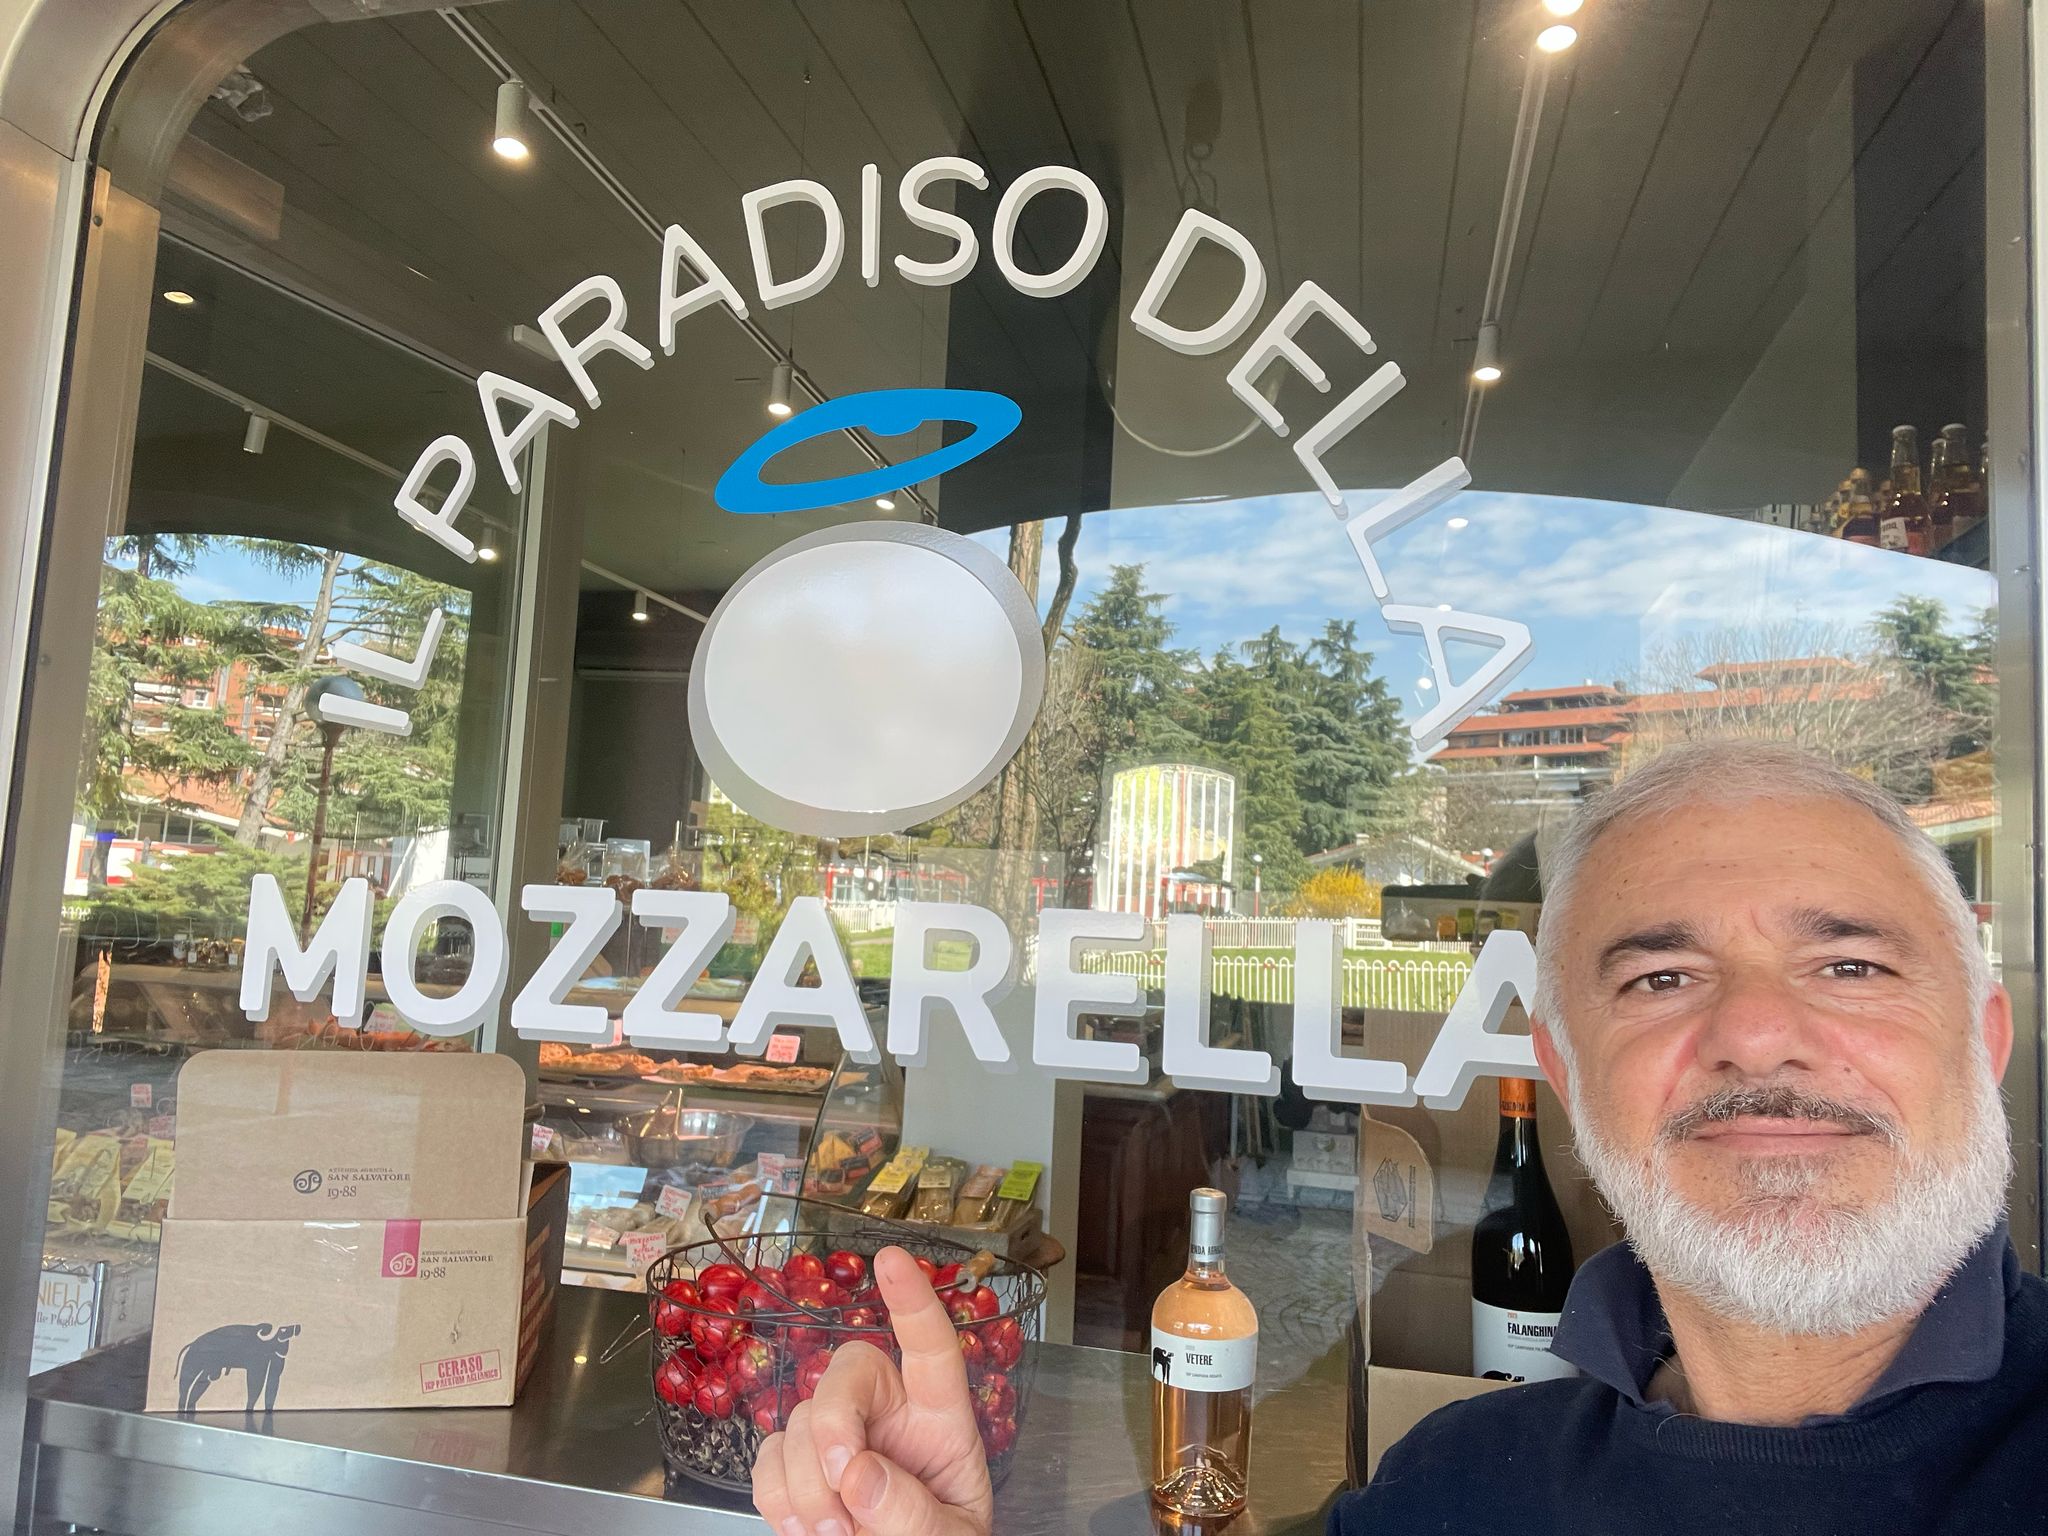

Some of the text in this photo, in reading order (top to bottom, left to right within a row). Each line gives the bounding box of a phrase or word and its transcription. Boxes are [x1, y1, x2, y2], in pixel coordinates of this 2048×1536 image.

[318, 156, 1532, 754] IL PARADISO DELLA
[239, 873, 1550, 1108] MOZZARELLA
[442, 1255, 494, 1263] SALVATORE
[438, 1355, 483, 1378] CERASO
[1185, 1353, 1213, 1366] VETERE
